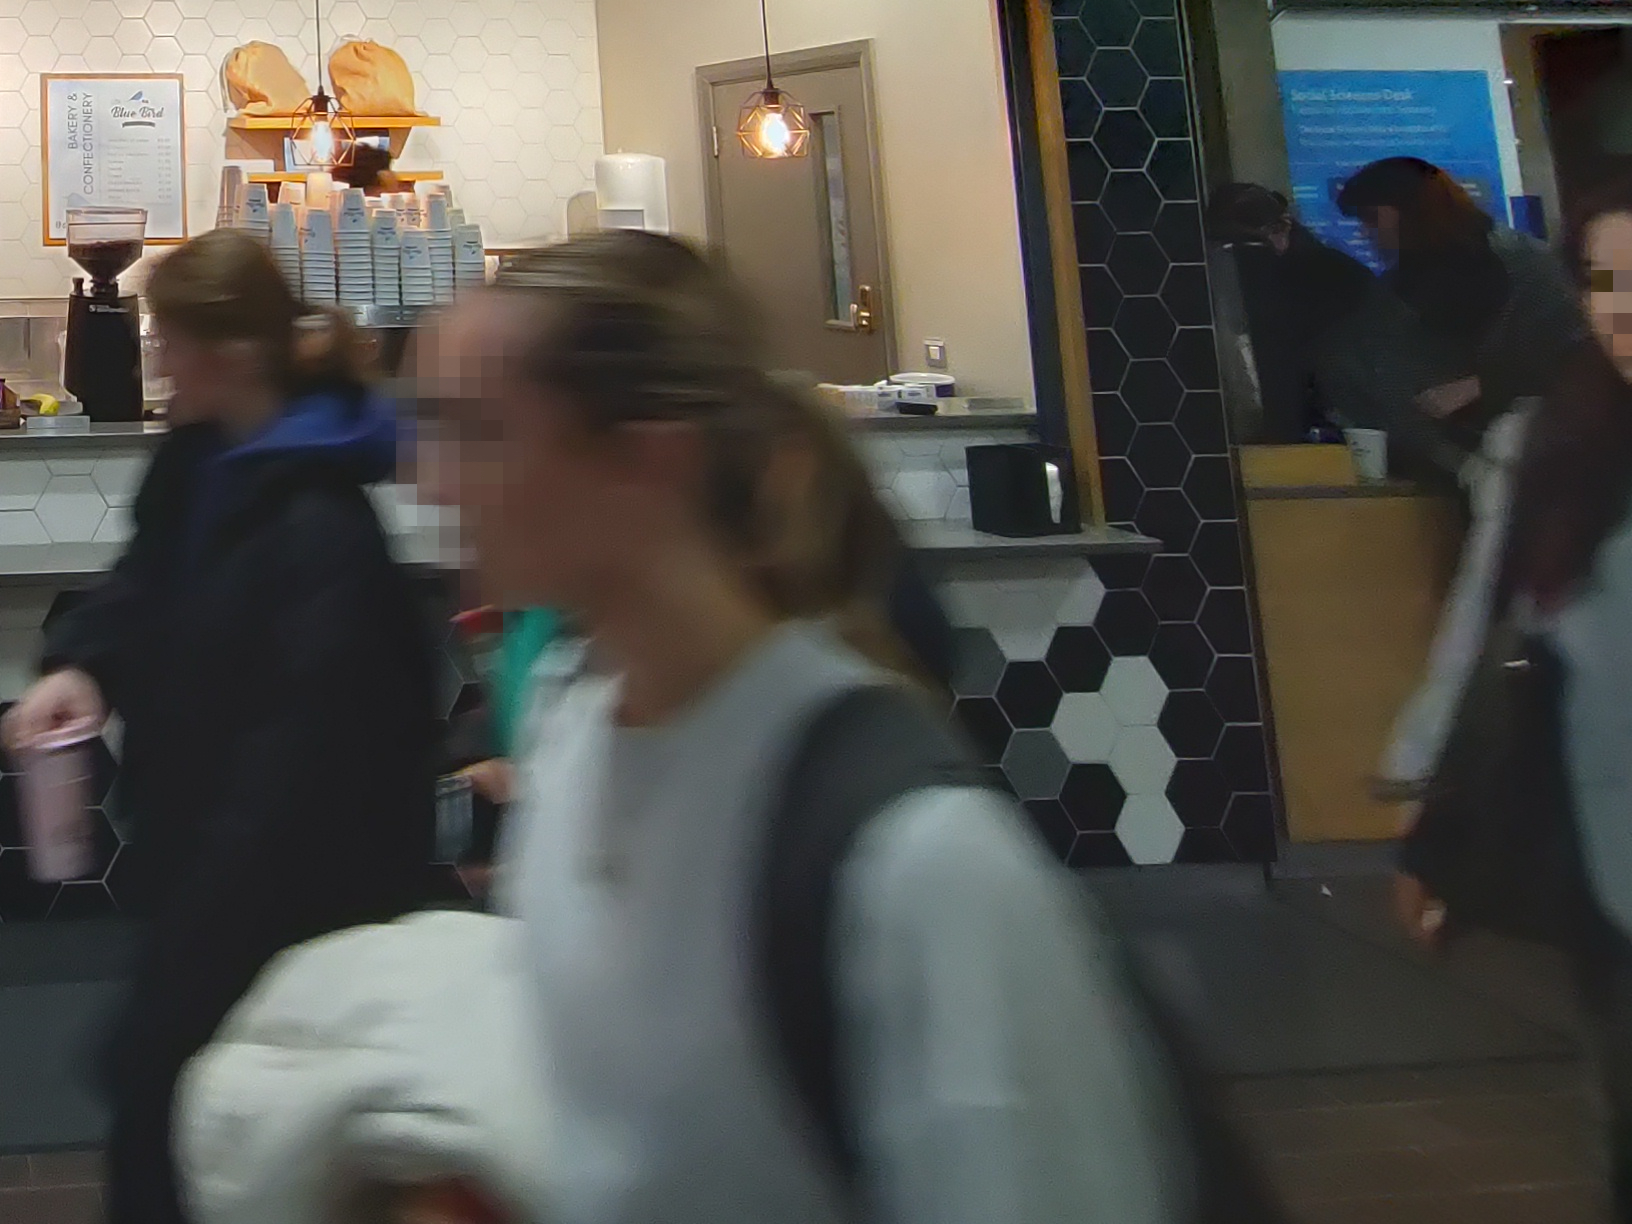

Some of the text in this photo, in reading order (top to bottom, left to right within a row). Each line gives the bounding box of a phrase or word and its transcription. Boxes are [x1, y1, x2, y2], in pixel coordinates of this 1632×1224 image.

[67, 92, 79, 150] BAKERY &
[110, 105, 165, 119] Blue Bird
[82, 92, 94, 195] CONFECTIONERY
